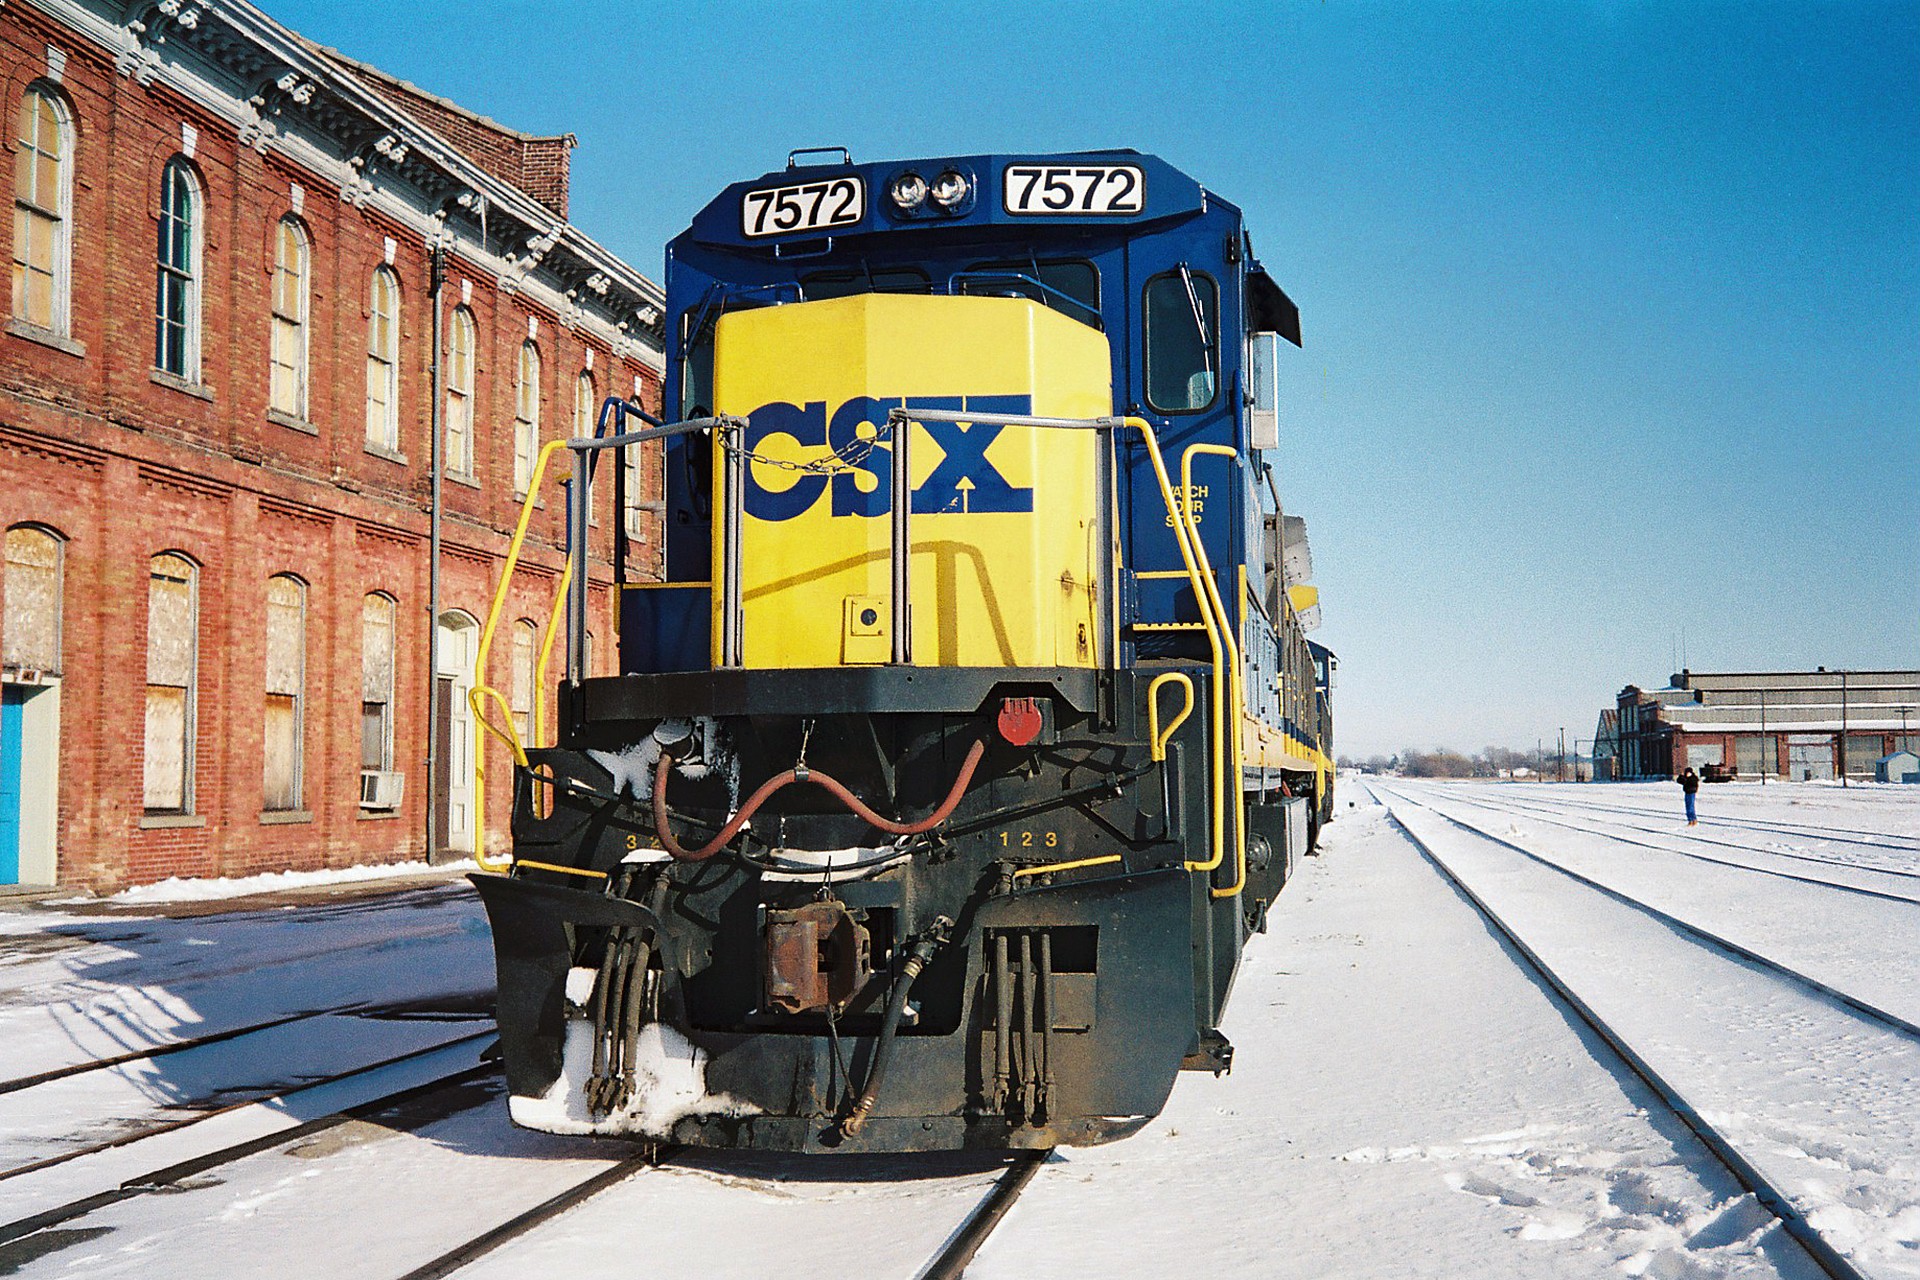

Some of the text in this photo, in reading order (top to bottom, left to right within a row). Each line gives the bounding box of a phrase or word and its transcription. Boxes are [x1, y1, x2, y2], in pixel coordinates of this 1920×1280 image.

[1012, 168, 1137, 211] 7572
[748, 179, 858, 234] 7572
[742, 395, 1034, 522] CSX
[1163, 485, 1209, 498] ACH
[626, 835, 637, 849] 3
[650, 836, 660, 849] 2
[1000, 831, 1057, 847] 1 2 3
